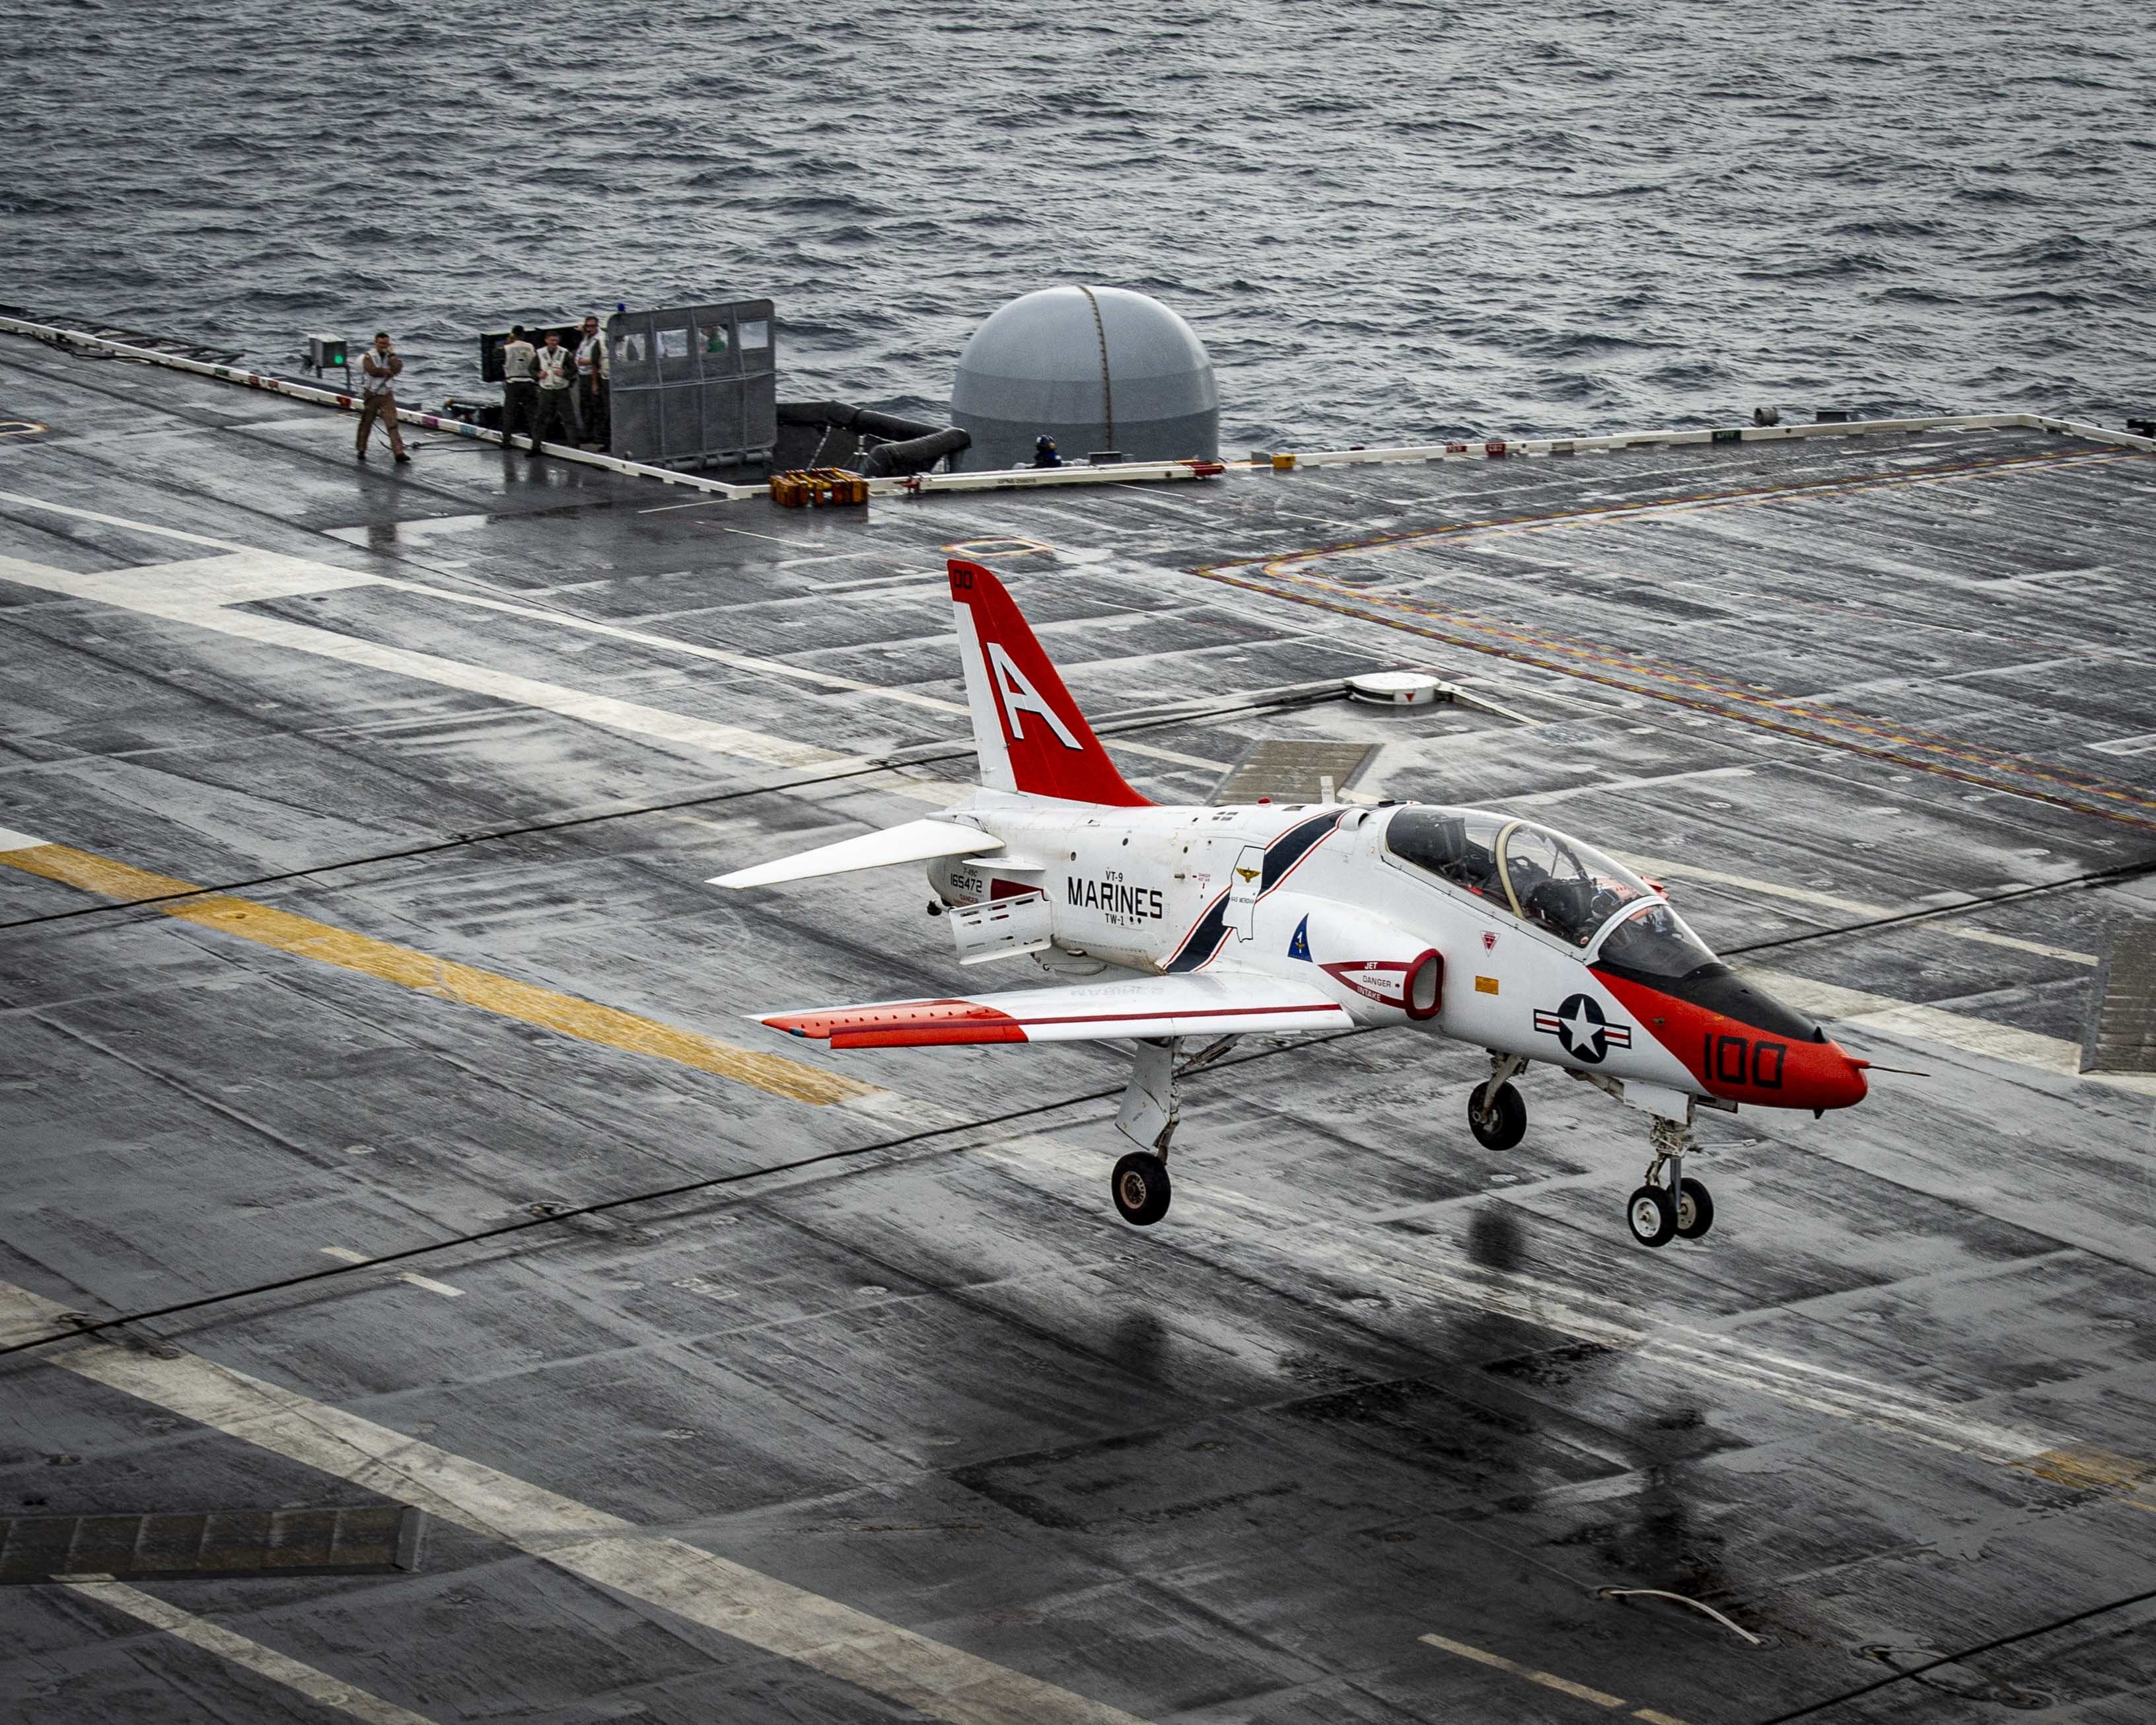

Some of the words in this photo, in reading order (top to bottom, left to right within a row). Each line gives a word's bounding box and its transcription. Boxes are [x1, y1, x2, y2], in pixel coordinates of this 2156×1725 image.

[953, 569, 973, 589] 00
[986, 642, 1083, 751] A
[950, 873, 983, 893] 165472
[1105, 870, 1124, 883] VT-9
[1067, 876, 1163, 919] MARINES
[1104, 913, 1124, 926] TW-1
[1364, 961, 1379, 970] JET
[1363, 974, 1391, 988] DANGER
[1357, 985, 1382, 1002] INTAKE
[1704, 1033, 1787, 1089] 100
